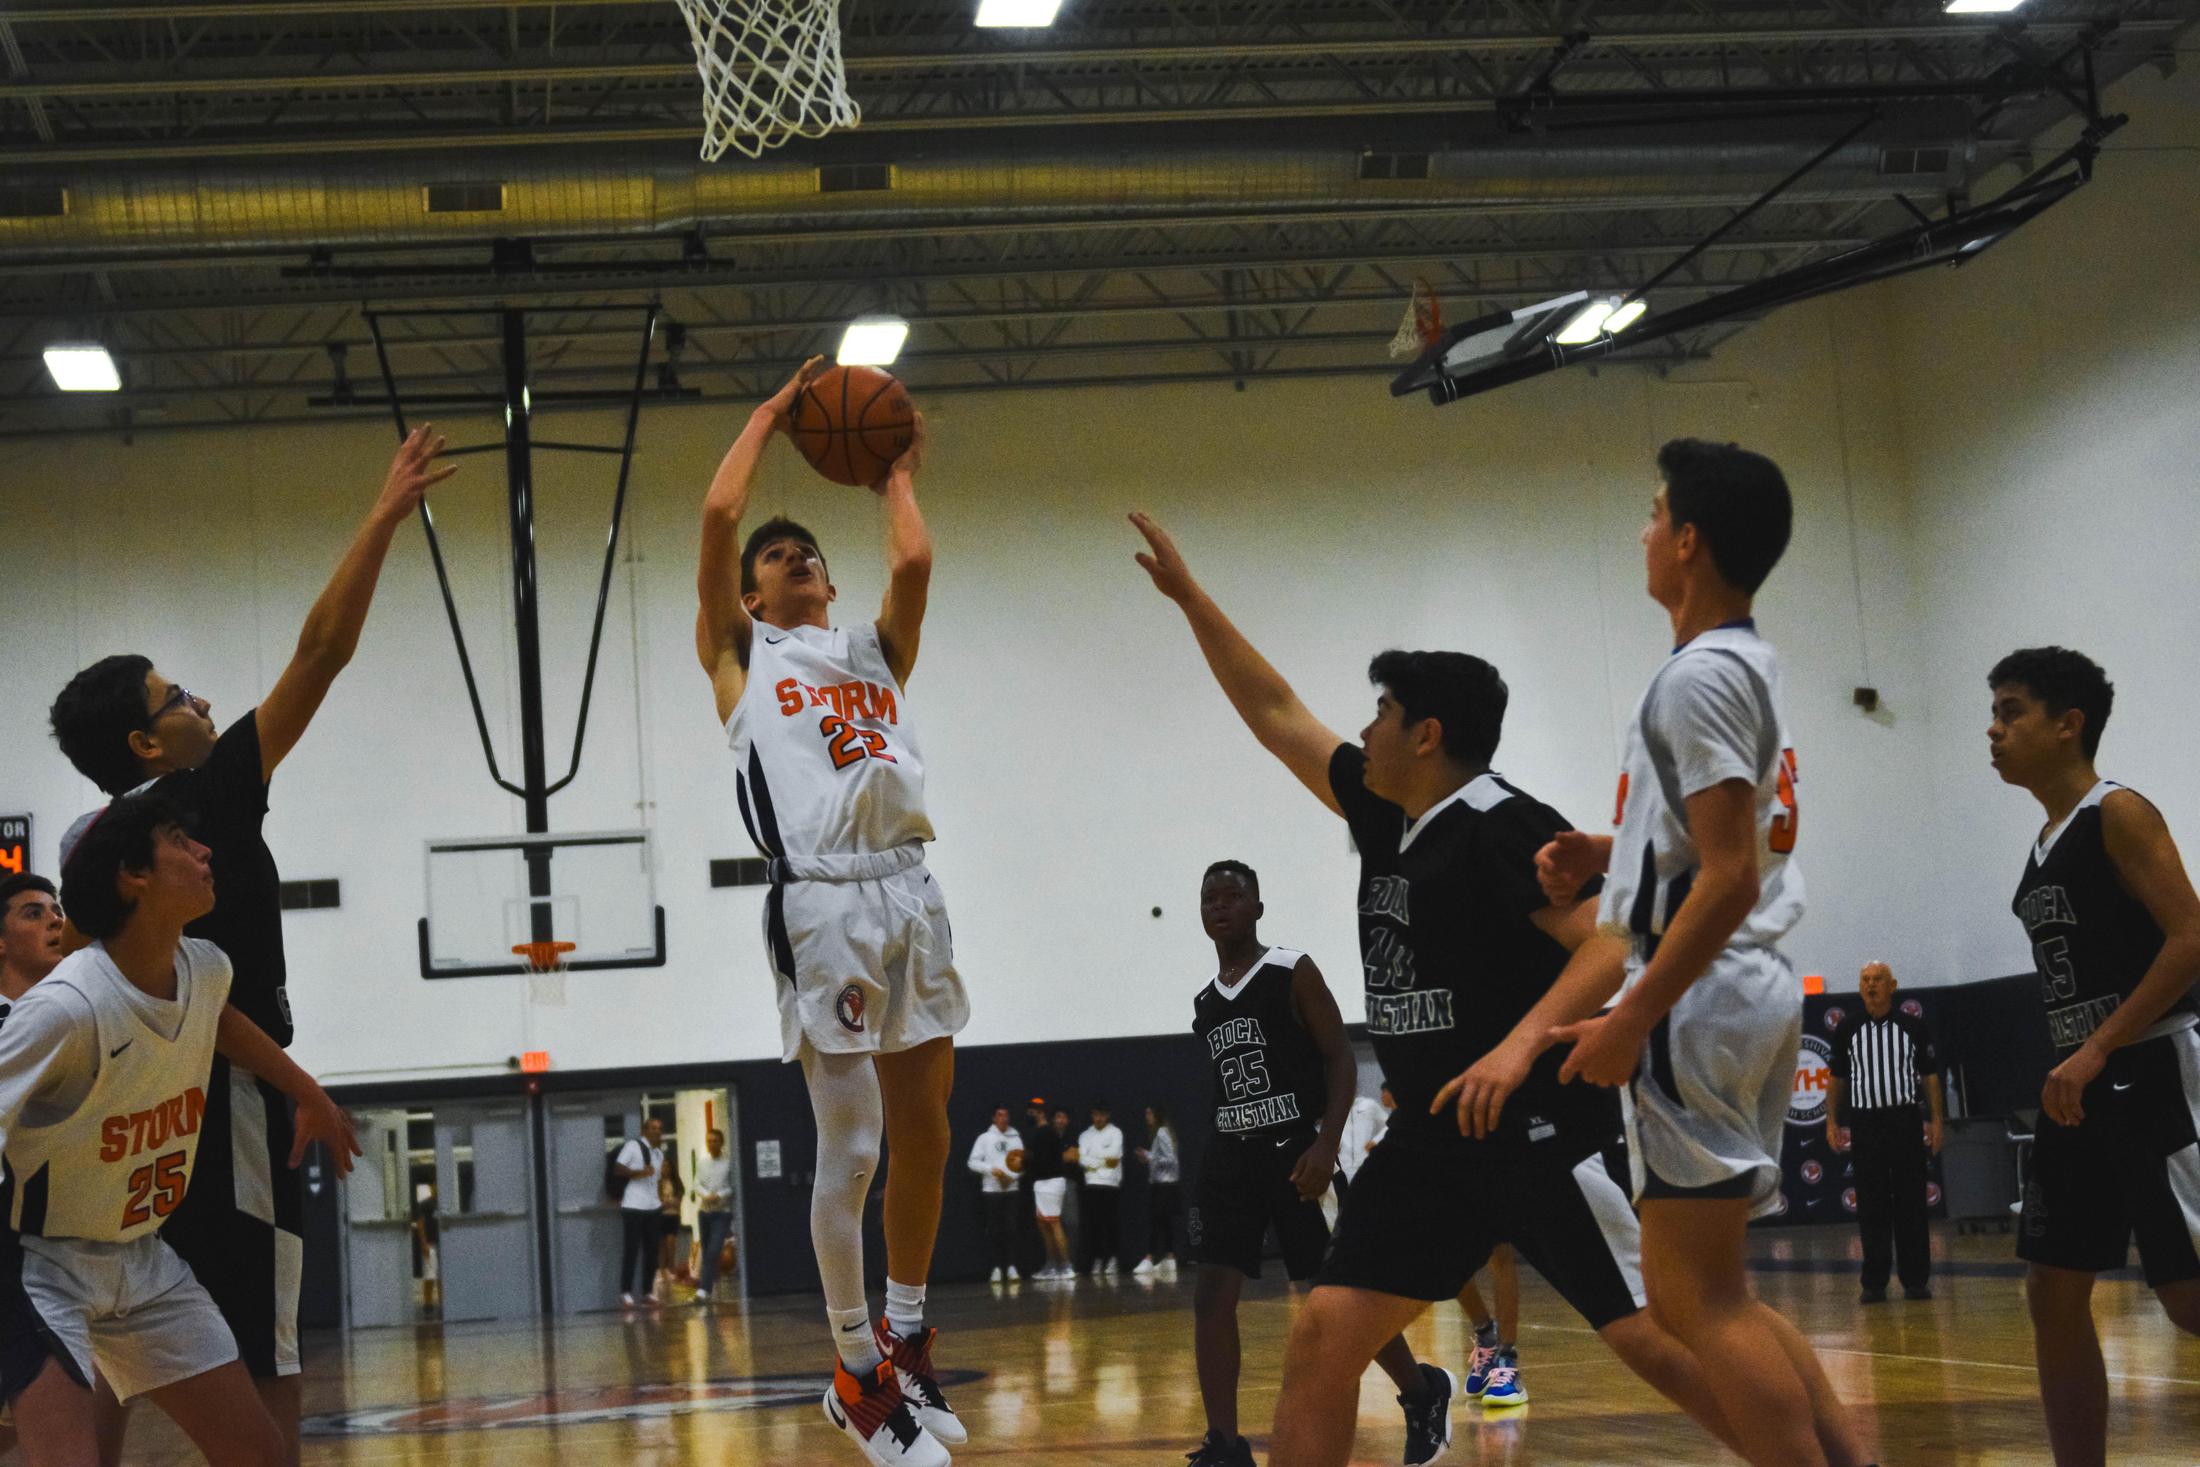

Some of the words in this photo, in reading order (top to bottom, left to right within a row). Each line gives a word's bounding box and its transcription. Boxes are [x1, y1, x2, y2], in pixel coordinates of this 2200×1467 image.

[0, 821, 25, 838] OR
[1207, 1017, 1267, 1059] BOCA
[1220, 1049, 1271, 1101] 25
[1215, 1092, 1300, 1132] CHRISTIAN
[120, 1149, 187, 1231] 25
